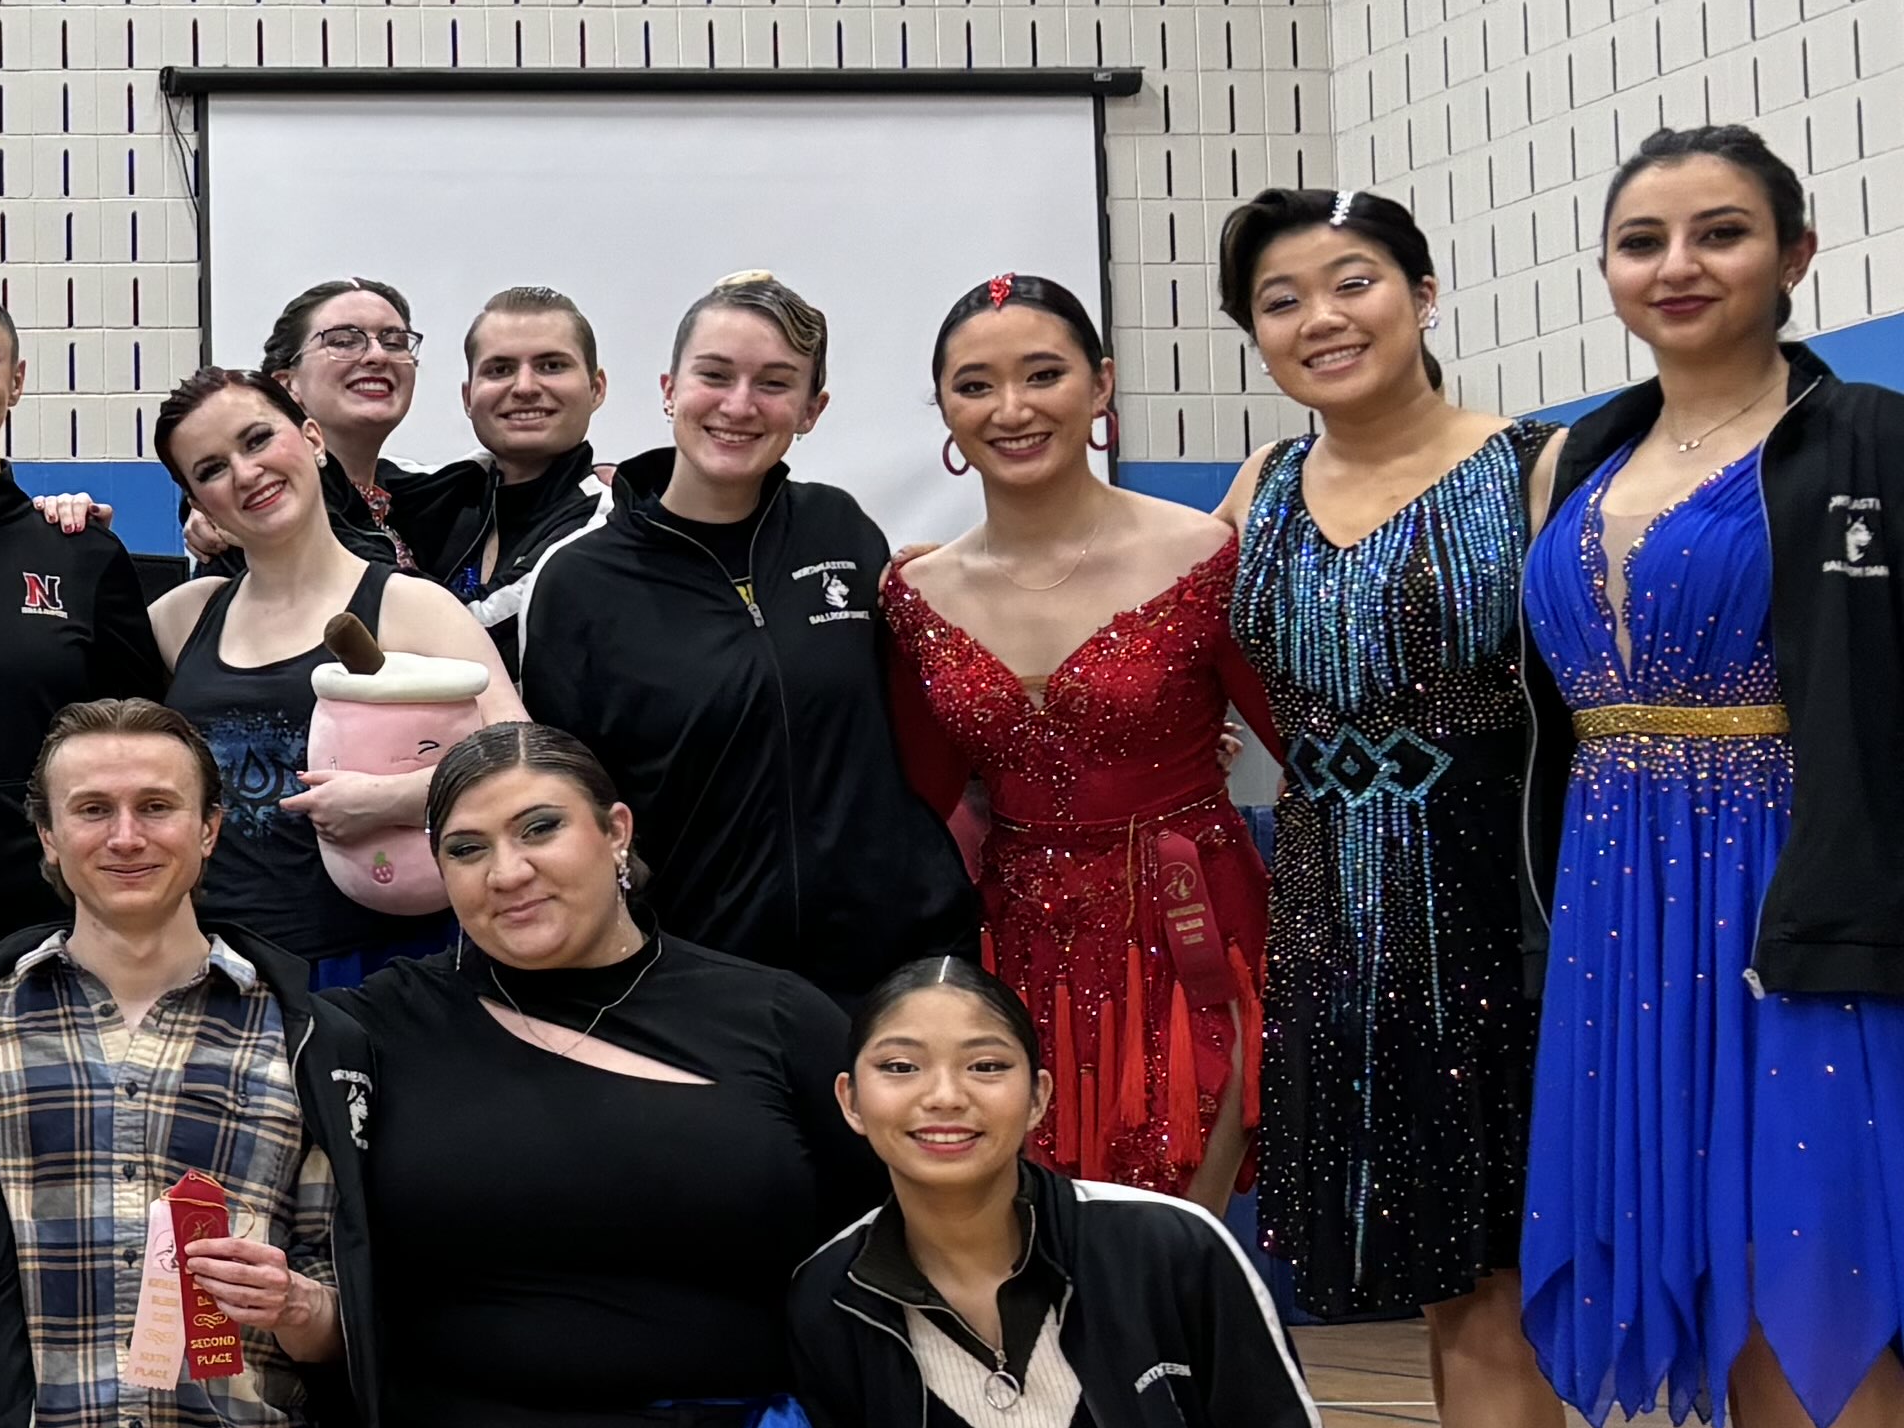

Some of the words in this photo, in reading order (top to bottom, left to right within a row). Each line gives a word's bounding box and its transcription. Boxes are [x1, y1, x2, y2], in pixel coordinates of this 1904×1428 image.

[22, 572, 63, 610] N
[190, 1335, 236, 1349] SECOND
[197, 1353, 233, 1367] PLACE
